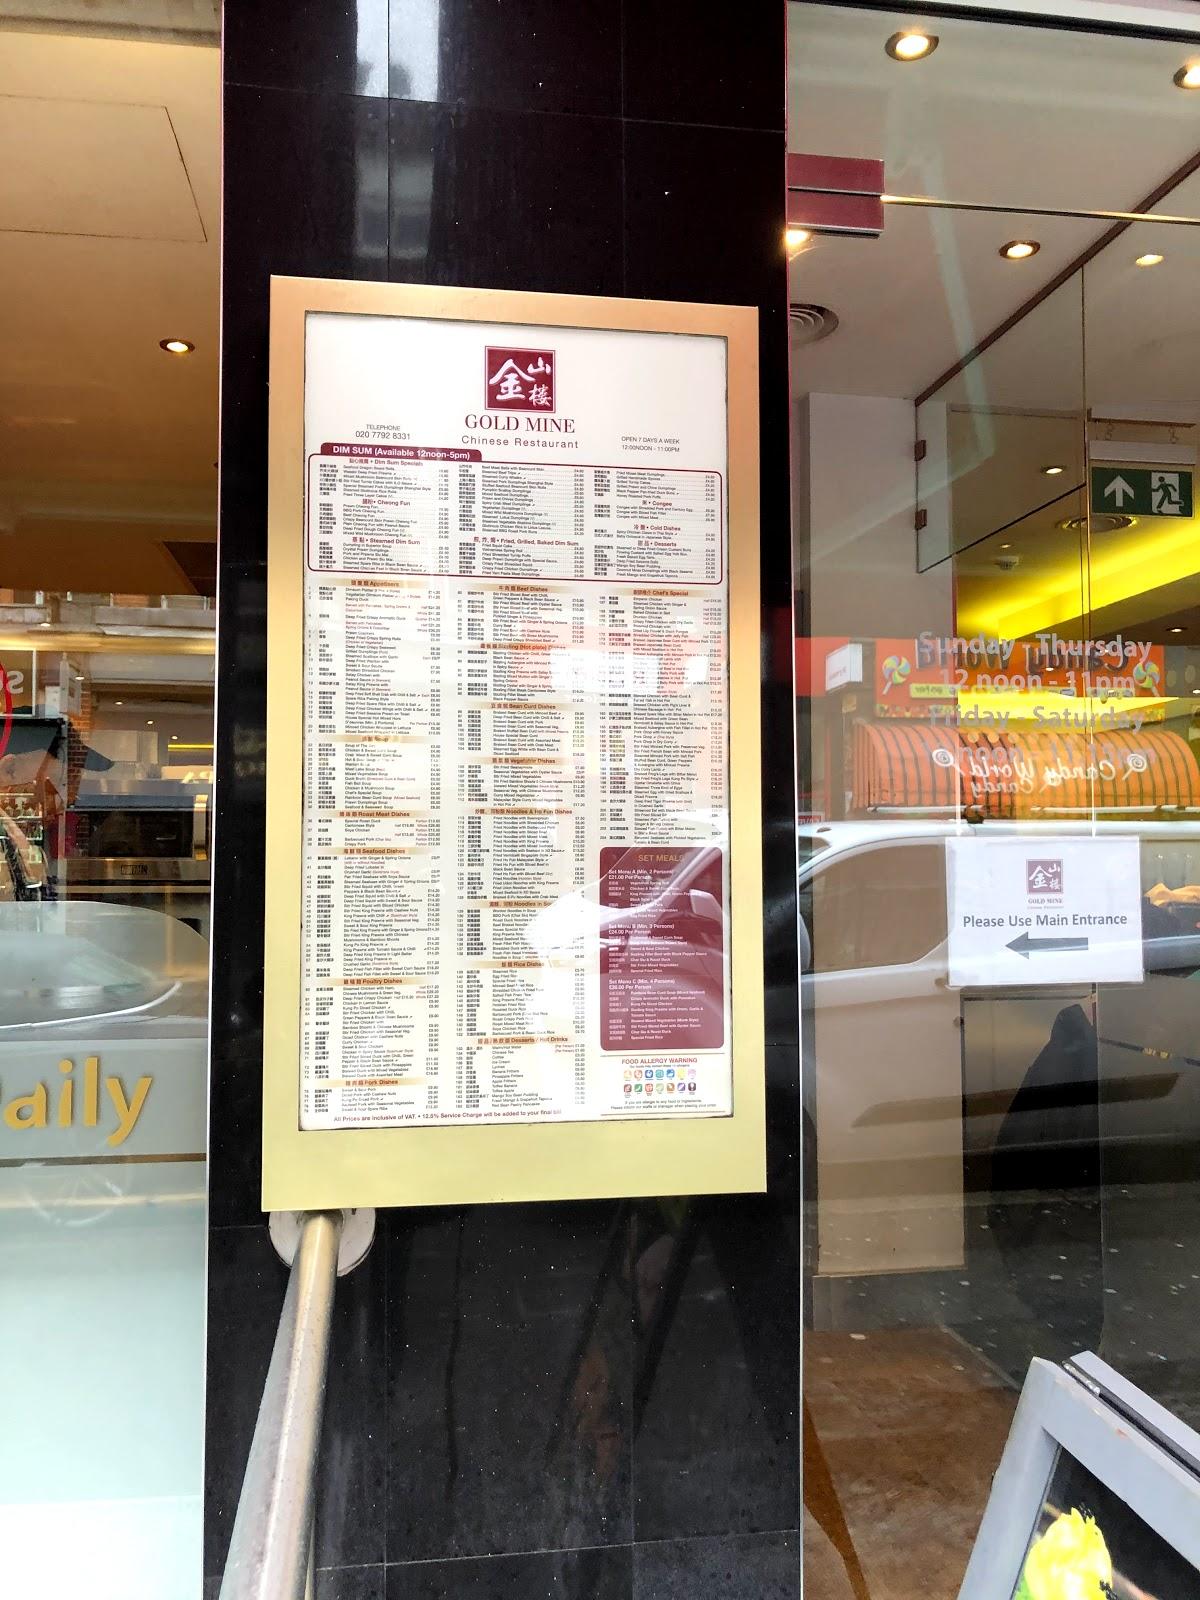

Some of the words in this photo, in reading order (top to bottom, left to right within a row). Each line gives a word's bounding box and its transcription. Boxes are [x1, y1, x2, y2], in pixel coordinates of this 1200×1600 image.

[366, 424, 401, 432] TELEPHONE
[464, 413, 520, 431] GOLD
[525, 417, 576, 433] MINE
[355, 430, 370, 439] 020
[372, 431, 391, 440] 7792
[392, 432, 411, 440] 8331
[461, 435, 510, 447] Chinese
[514, 437, 580, 449] Restaurant
[332, 445, 350, 454] DIM
[352, 446, 373, 455] SUM
[374, 447, 414, 457] (Available
[417, 450, 471, 460] 12noon-5pm)
[377, 499, 399, 507] Cheong
[920, 631, 1016, 661] Sunday
[1035, 633, 1153, 663] Thursday
[977, 673, 1043, 694] noon
[1066, 671, 1136, 698] 11pm
[929, 704, 1011, 730] Friday
[1033, 705, 1145, 733] Saturday
[963, 915, 1005, 929] Please
[1008, 915, 1032, 927] Use
[1036, 914, 1069, 927] Main
[1072, 913, 1128, 926] Entrance
[362, 978, 382, 986] Poultry
[0, 1056, 153, 1148] aily
[440, 1111, 462, 1119] Service
[462, 1111, 483, 1119] Charge
